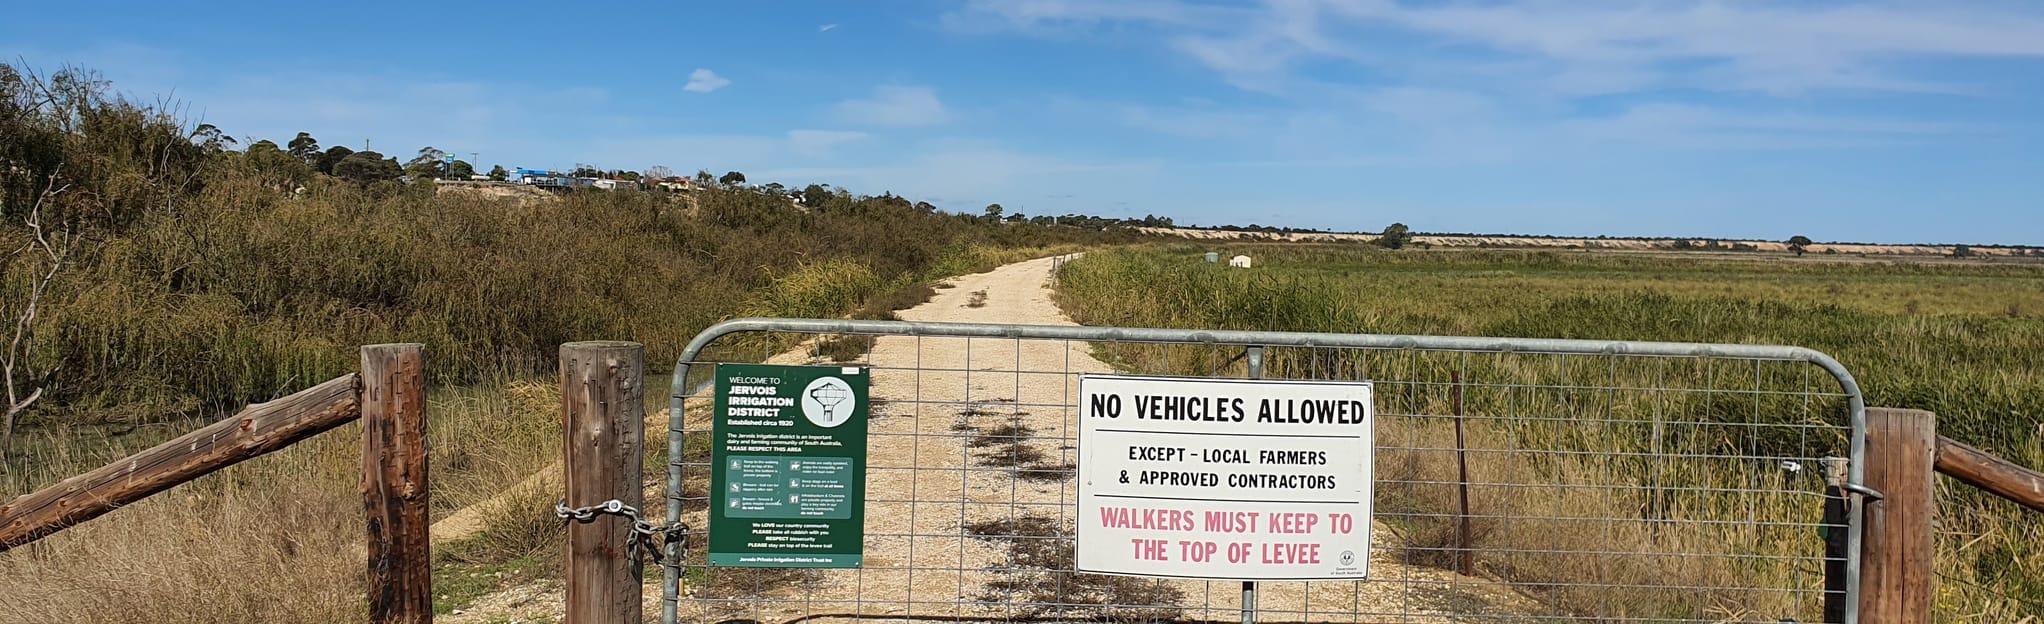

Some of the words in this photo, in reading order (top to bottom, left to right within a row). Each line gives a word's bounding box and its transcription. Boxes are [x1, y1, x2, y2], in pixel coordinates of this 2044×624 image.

[728, 386, 776, 395] JERVOIS
[728, 396, 794, 406] IRRIGATION
[1090, 393, 1122, 418] NO
[1135, 395, 1244, 422] VEHICLES
[1258, 399, 1364, 424] ALLOWED
[728, 407, 780, 417] DISTRICT
[1129, 446, 1185, 462] EXCEPT
[1203, 449, 1250, 464] LOCAL
[1259, 450, 1326, 465] FARMERS
[1119, 470, 1129, 484] &
[1140, 470, 1218, 487] APPROVED
[1228, 474, 1336, 490] CONTRACTORS
[1100, 507, 1195, 531] WALKERS
[1204, 511, 1259, 533] MUST
[1269, 513, 1318, 534] KEEP
[1328, 513, 1353, 534] TO
[1132, 539, 1168, 561] THE
[1179, 541, 1217, 562] TOP
[1228, 542, 1252, 564] OF
[1262, 543, 1320, 564] LEVEE
